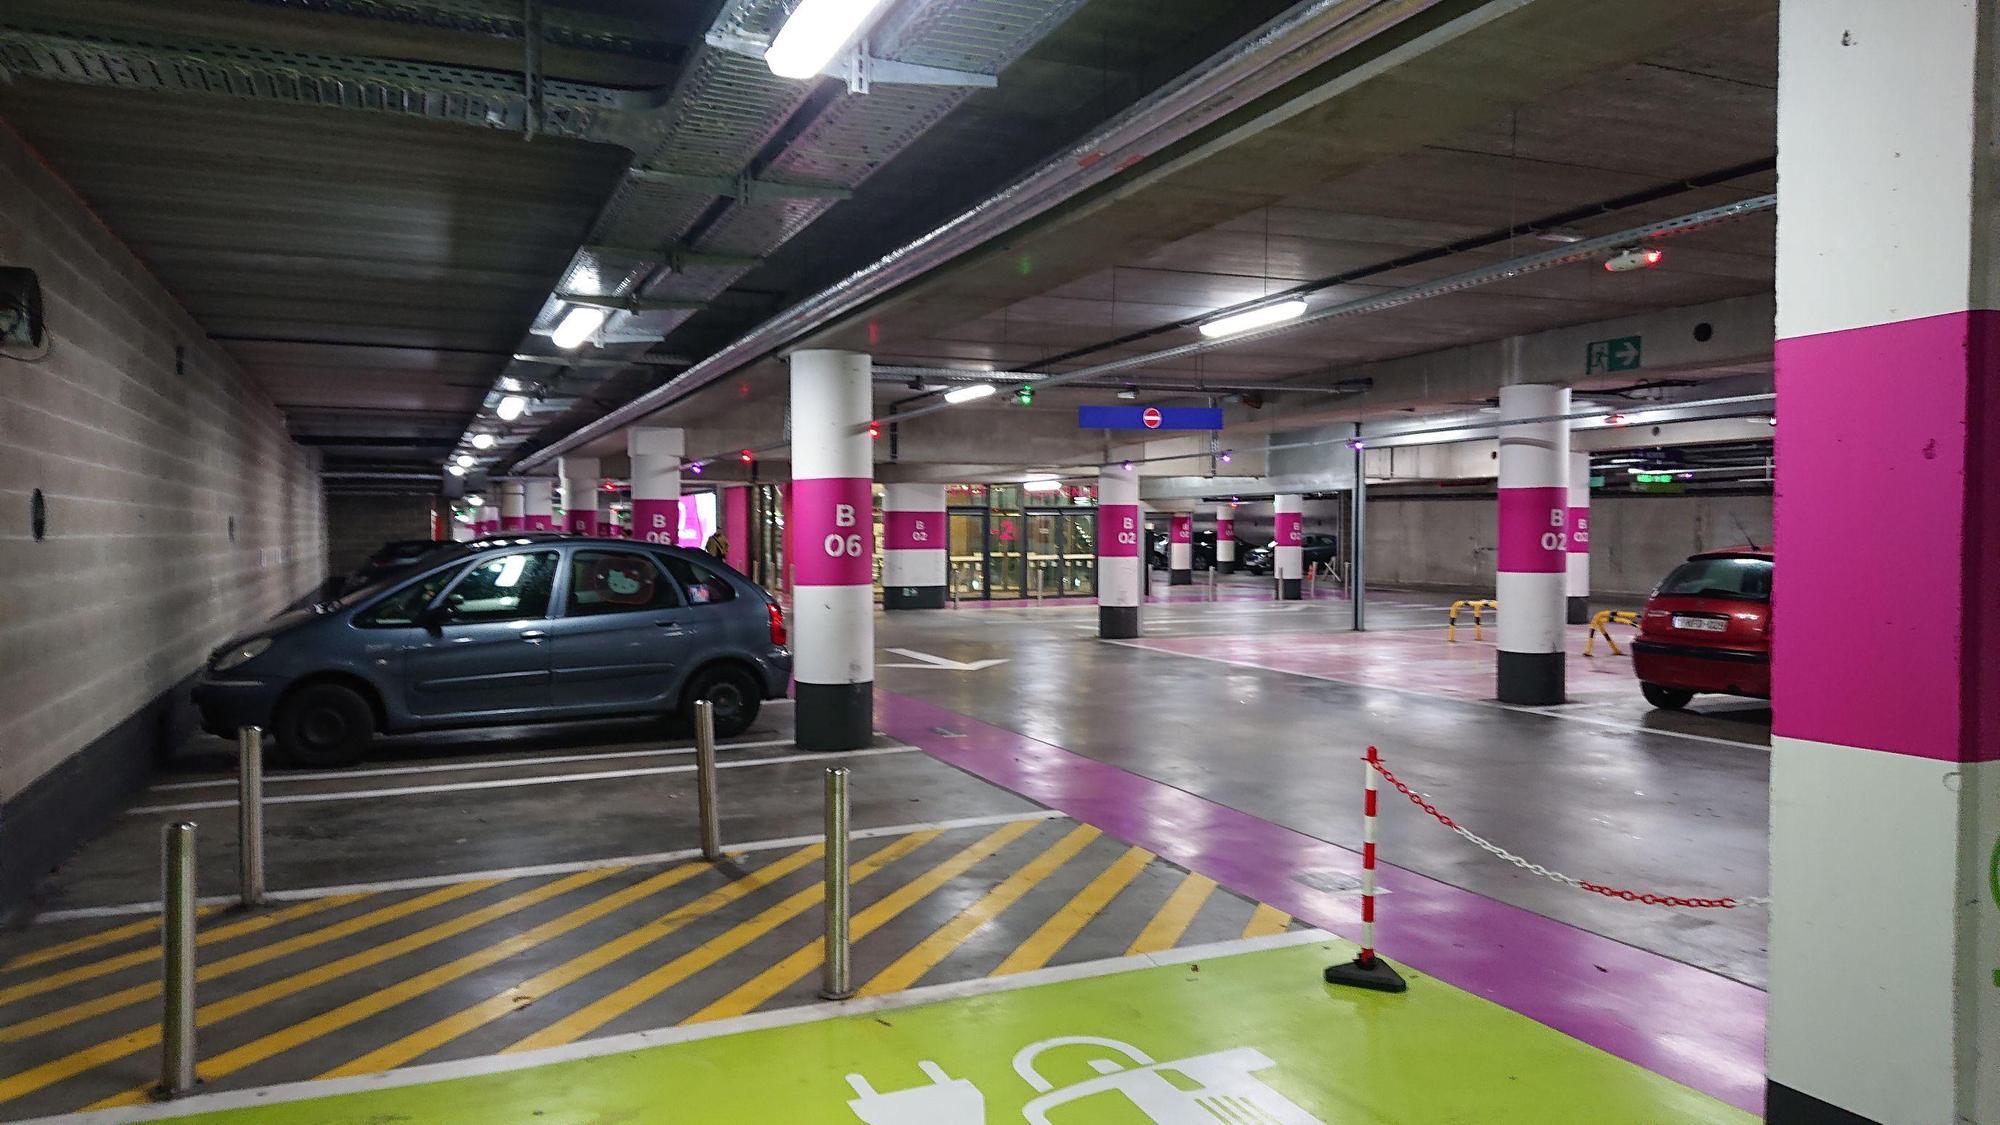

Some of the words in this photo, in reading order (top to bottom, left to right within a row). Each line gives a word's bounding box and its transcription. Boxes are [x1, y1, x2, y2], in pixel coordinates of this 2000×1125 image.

[652, 514, 667, 528] B
[836, 504, 856, 527] B
[1551, 509, 1564, 526] B
[916, 520, 926, 530] B
[1123, 517, 1134, 529] B
[1578, 519, 1587, 529] B
[912, 531, 929, 541] 02
[1118, 532, 1136, 544] 02
[1541, 533, 1567, 550] 02
[824, 533, 864, 557] 06
